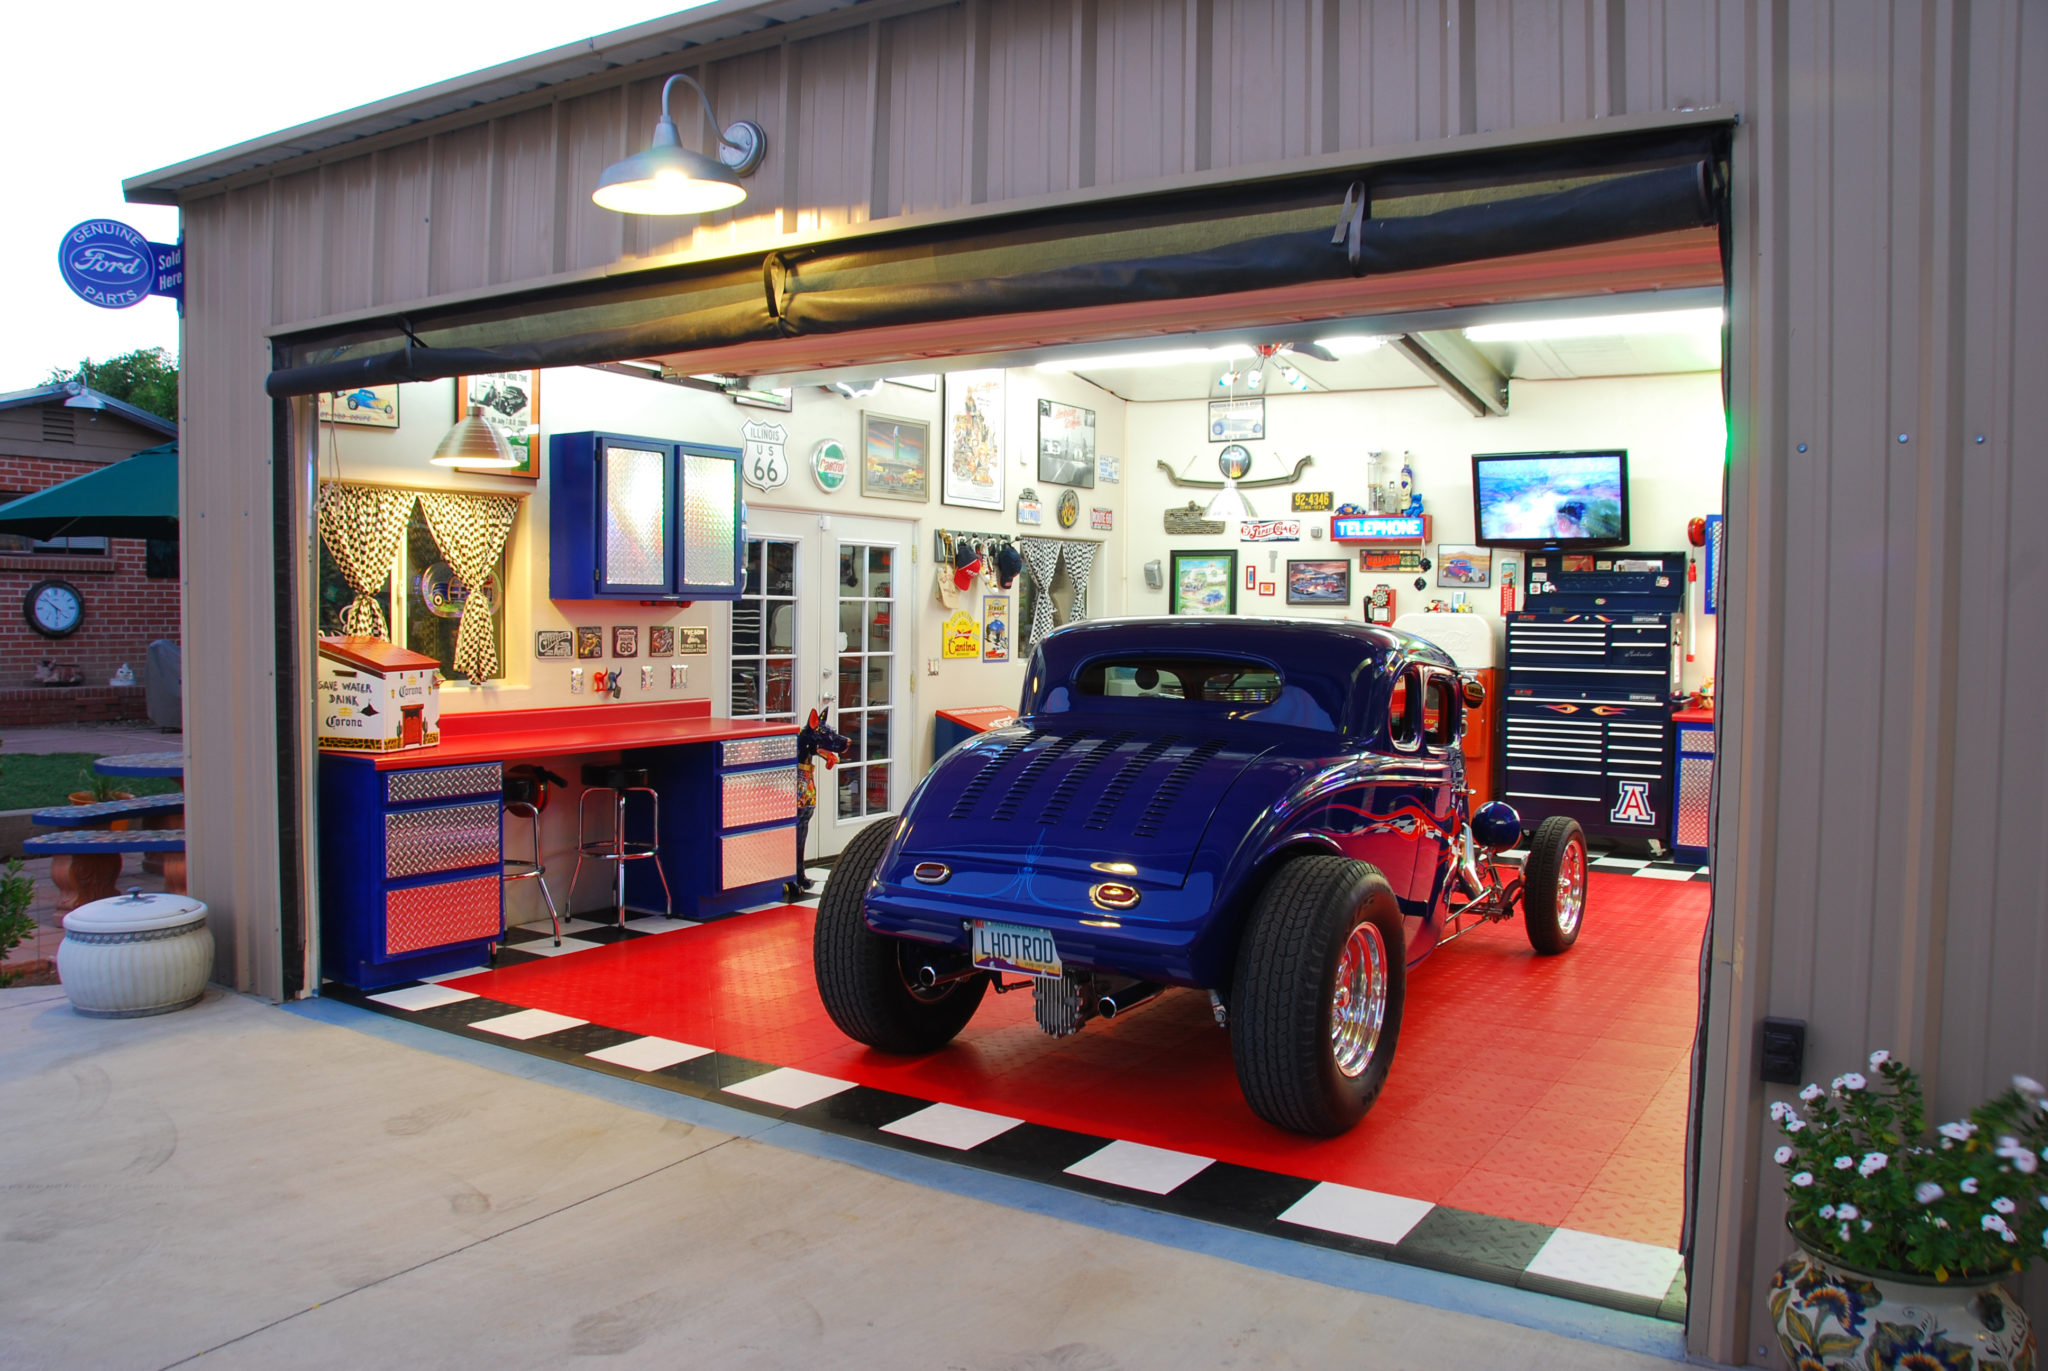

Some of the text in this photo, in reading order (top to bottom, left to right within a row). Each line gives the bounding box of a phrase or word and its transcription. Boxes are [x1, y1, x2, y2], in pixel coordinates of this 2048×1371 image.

[73, 223, 141, 247] GENUINE
[74, 248, 141, 275] Ford
[158, 249, 181, 271] Sold
[159, 272, 182, 291] Here
[83, 285, 137, 305] PARTS
[750, 427, 780, 442] ILLINOIS
[757, 444, 774, 456] U S
[754, 457, 778, 482] 66
[819, 458, 845, 473] Castrol
[1337, 520, 1421, 536] TELEPHONE
[619, 642, 633, 653] 66
[318, 680, 372, 694] SAVE WATER
[399, 685, 422, 698] Corona
[329, 694, 359, 706] DRINK
[326, 715, 362, 729] Corona
[1610, 780, 1655, 825] A
[980, 930, 1053, 964] LHOTROD
